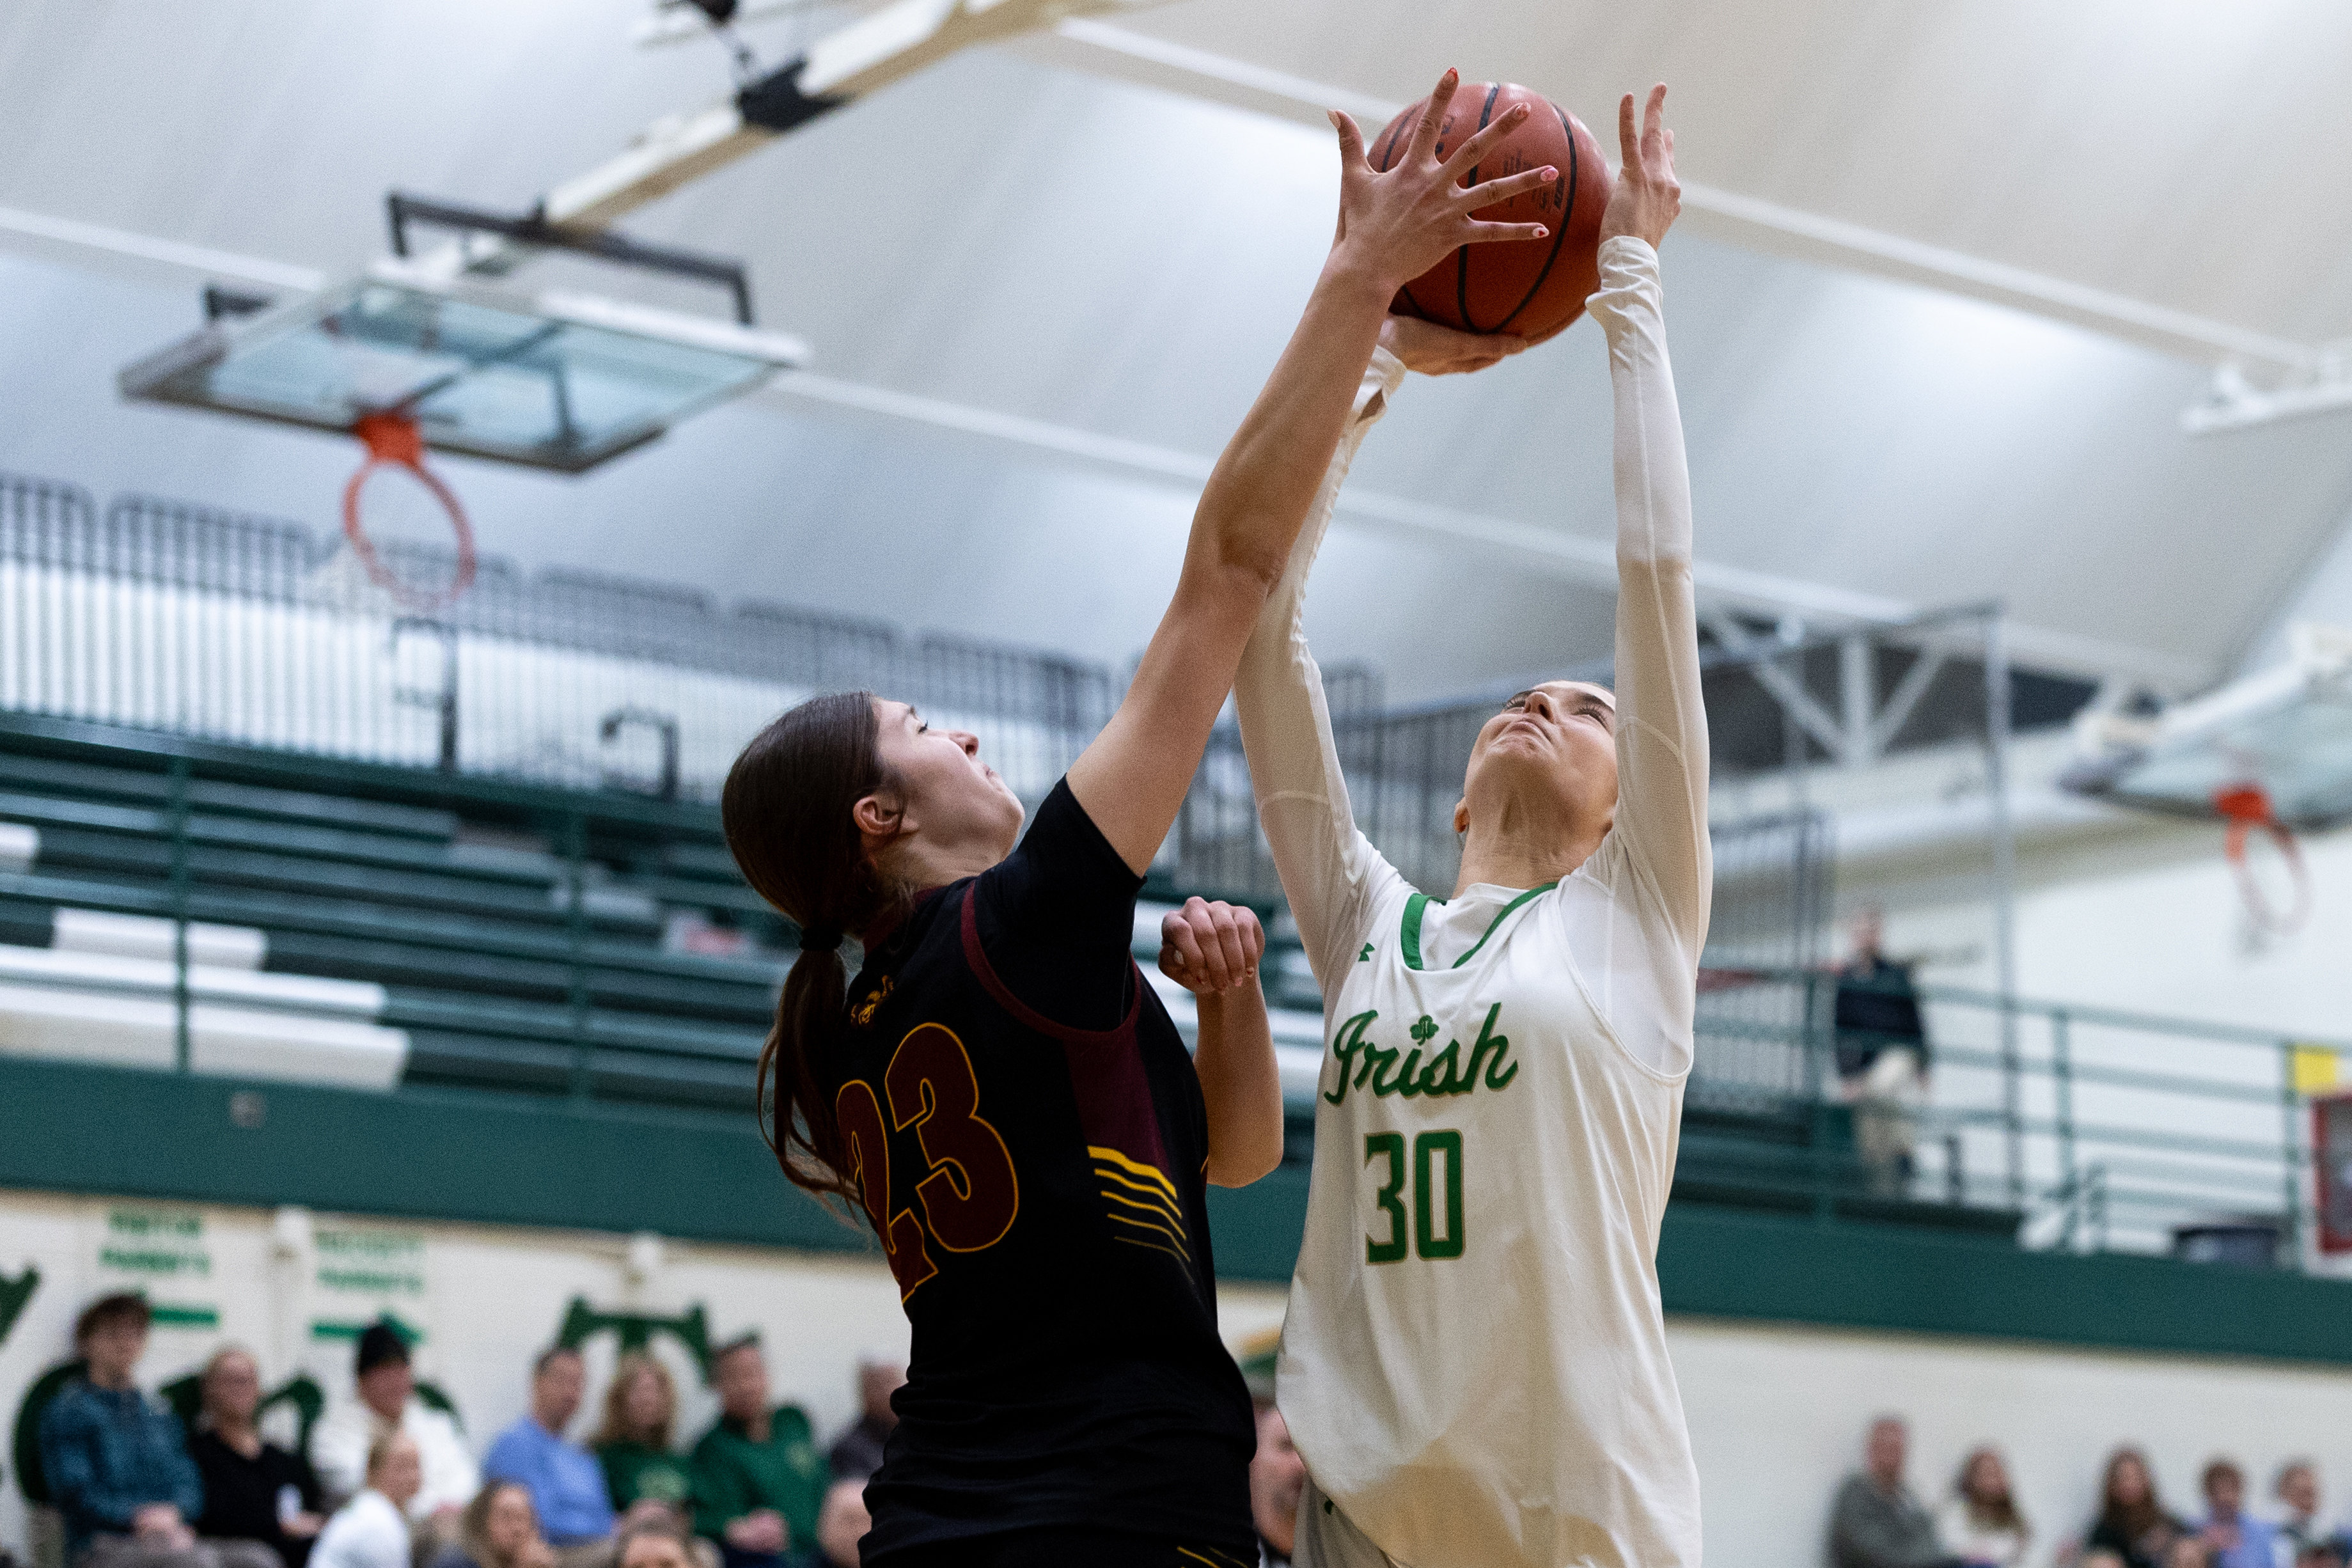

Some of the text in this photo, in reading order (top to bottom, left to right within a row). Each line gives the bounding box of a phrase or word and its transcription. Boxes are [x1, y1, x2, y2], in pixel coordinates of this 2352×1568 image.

[1324, 1002, 1518, 1106] Irish
[836, 1022, 1019, 1303] 23
[1363, 1129, 1466, 1266] 30
